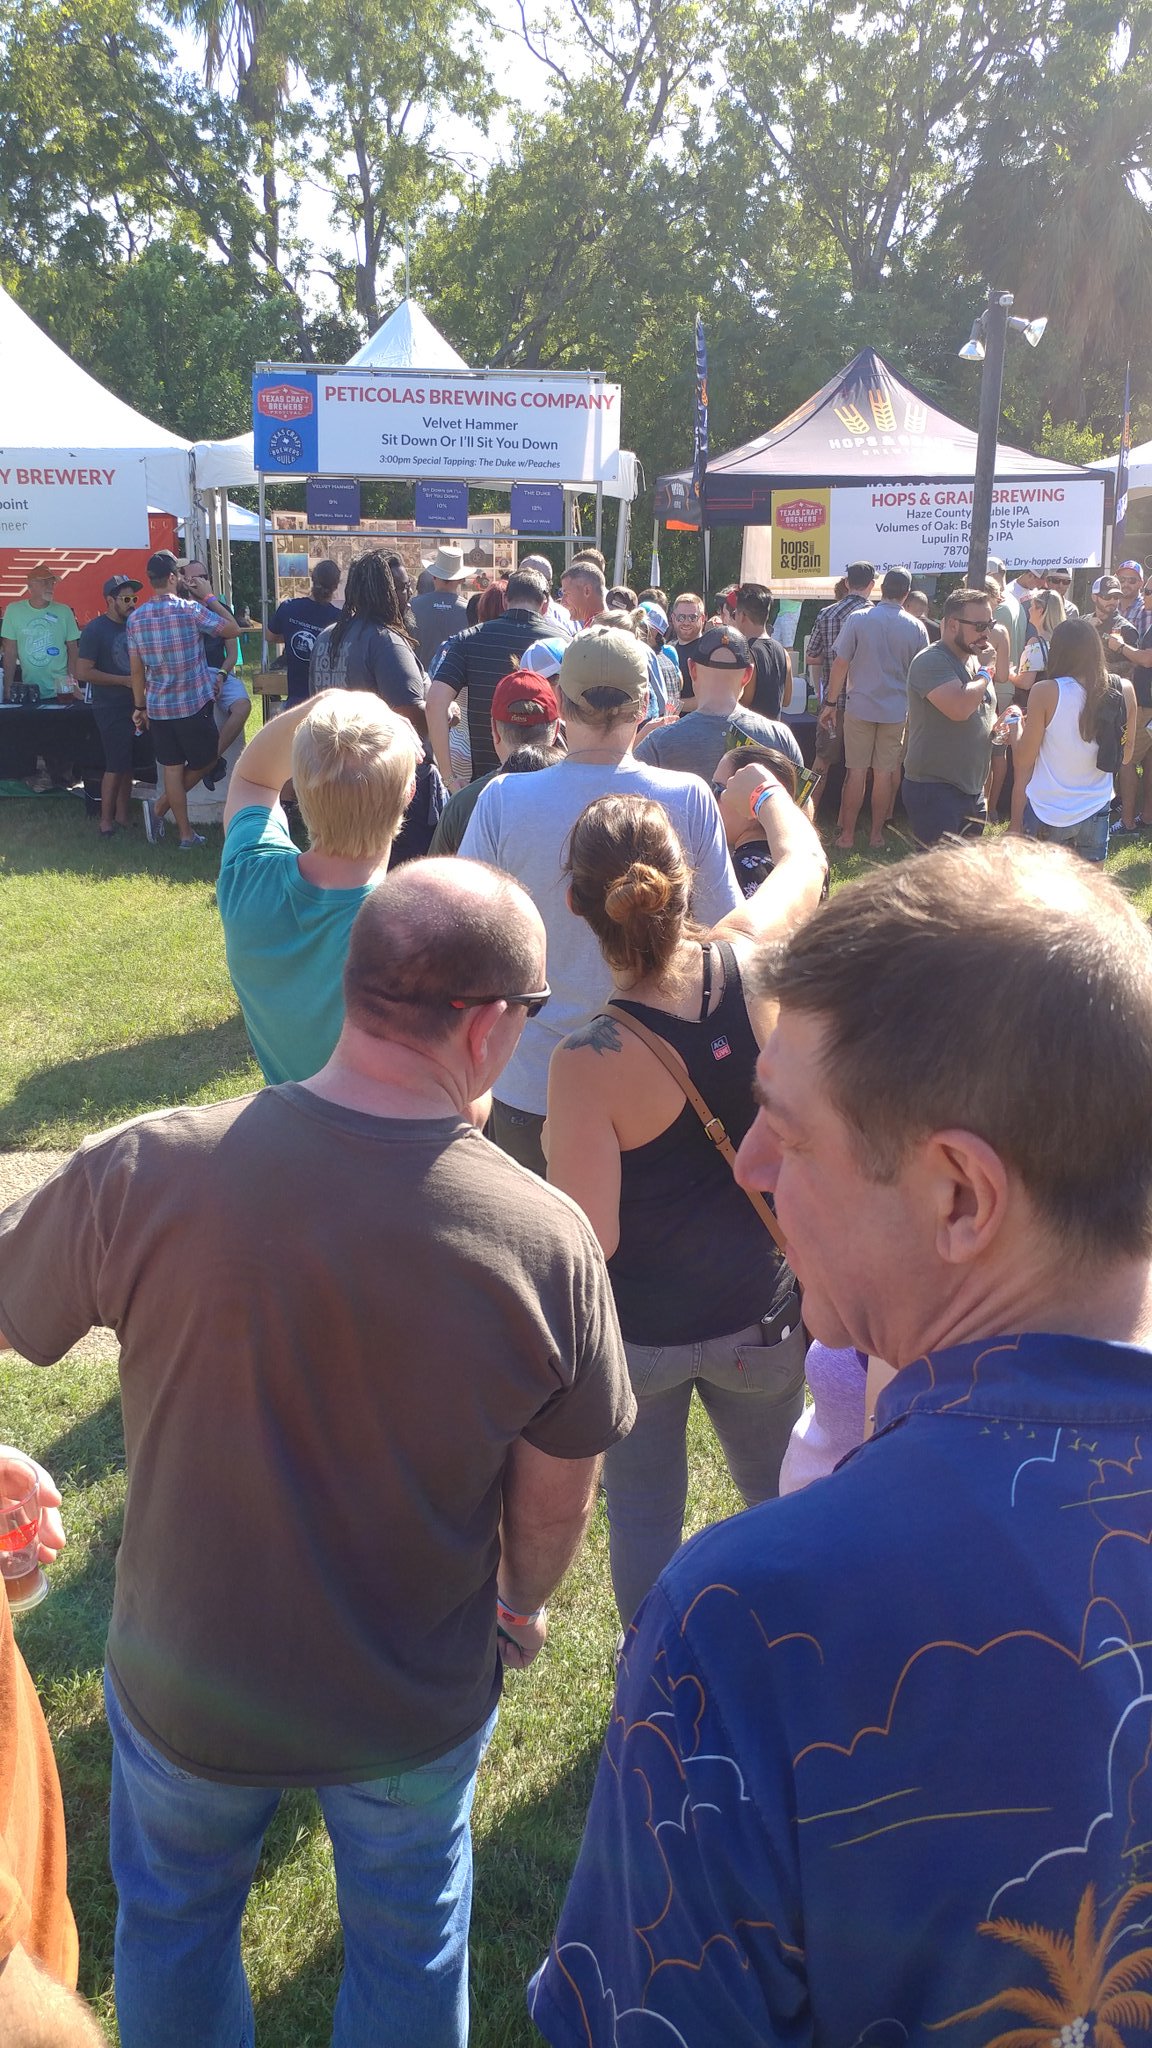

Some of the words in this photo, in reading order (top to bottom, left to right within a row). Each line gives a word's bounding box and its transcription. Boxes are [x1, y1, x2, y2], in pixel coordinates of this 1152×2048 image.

[262, 394, 285, 403] TEXAS
[286, 395, 309, 404] CRAFT
[325, 386, 425, 404] PETICOLAS
[429, 390, 517, 407] BREWING
[520, 392, 615, 410] COMPANY
[268, 402, 303, 411] BREWERS
[422, 416, 462, 429] Velvet
[465, 418, 518, 431] Hammer
[381, 433, 398, 446] Sit
[401, 434, 437, 447] Down
[440, 436, 456, 447] Or
[477, 436, 493, 448] Sit
[495, 437, 519, 450] You
[522, 437, 558, 450] Down
[828, 436, 878, 450] HOPS
[379, 455, 411, 465] 3:00pm
[412, 455, 441, 466] Special
[443, 456, 477, 468] Tapping:
[479, 457, 494, 467] The
[495, 458, 517, 468] Duke
[518, 458, 561, 469] w/Peaches
[16, 468, 116, 486] BREWERY
[871, 492, 916, 507] HOPS
[919, 492, 931, 506] &
[934, 490, 974, 505] GRAI
[780, 508, 800, 517] TEXAS
[801, 508, 823, 516] CRAFT
[785, 515, 817, 524] BREWERS
[906, 509, 933, 519] Haze
[934, 507, 972, 520] County
[1012, 506, 1030, 516] IPA
[875, 523, 920, 533] Volumes
[921, 521, 932, 531] of
[934, 519, 958, 531] Oak:
[1000, 519, 1025, 530] Style
[1027, 517, 1060, 529] Saison
[921, 532, 960, 546] Lupulin
[996, 531, 1014, 542] IPA
[780, 538, 809, 560] hops
[912, 559, 947, 572] Tapping:
[1013, 556, 1062, 568] Dry-hopped
[1062, 556, 1089, 566] Saison
